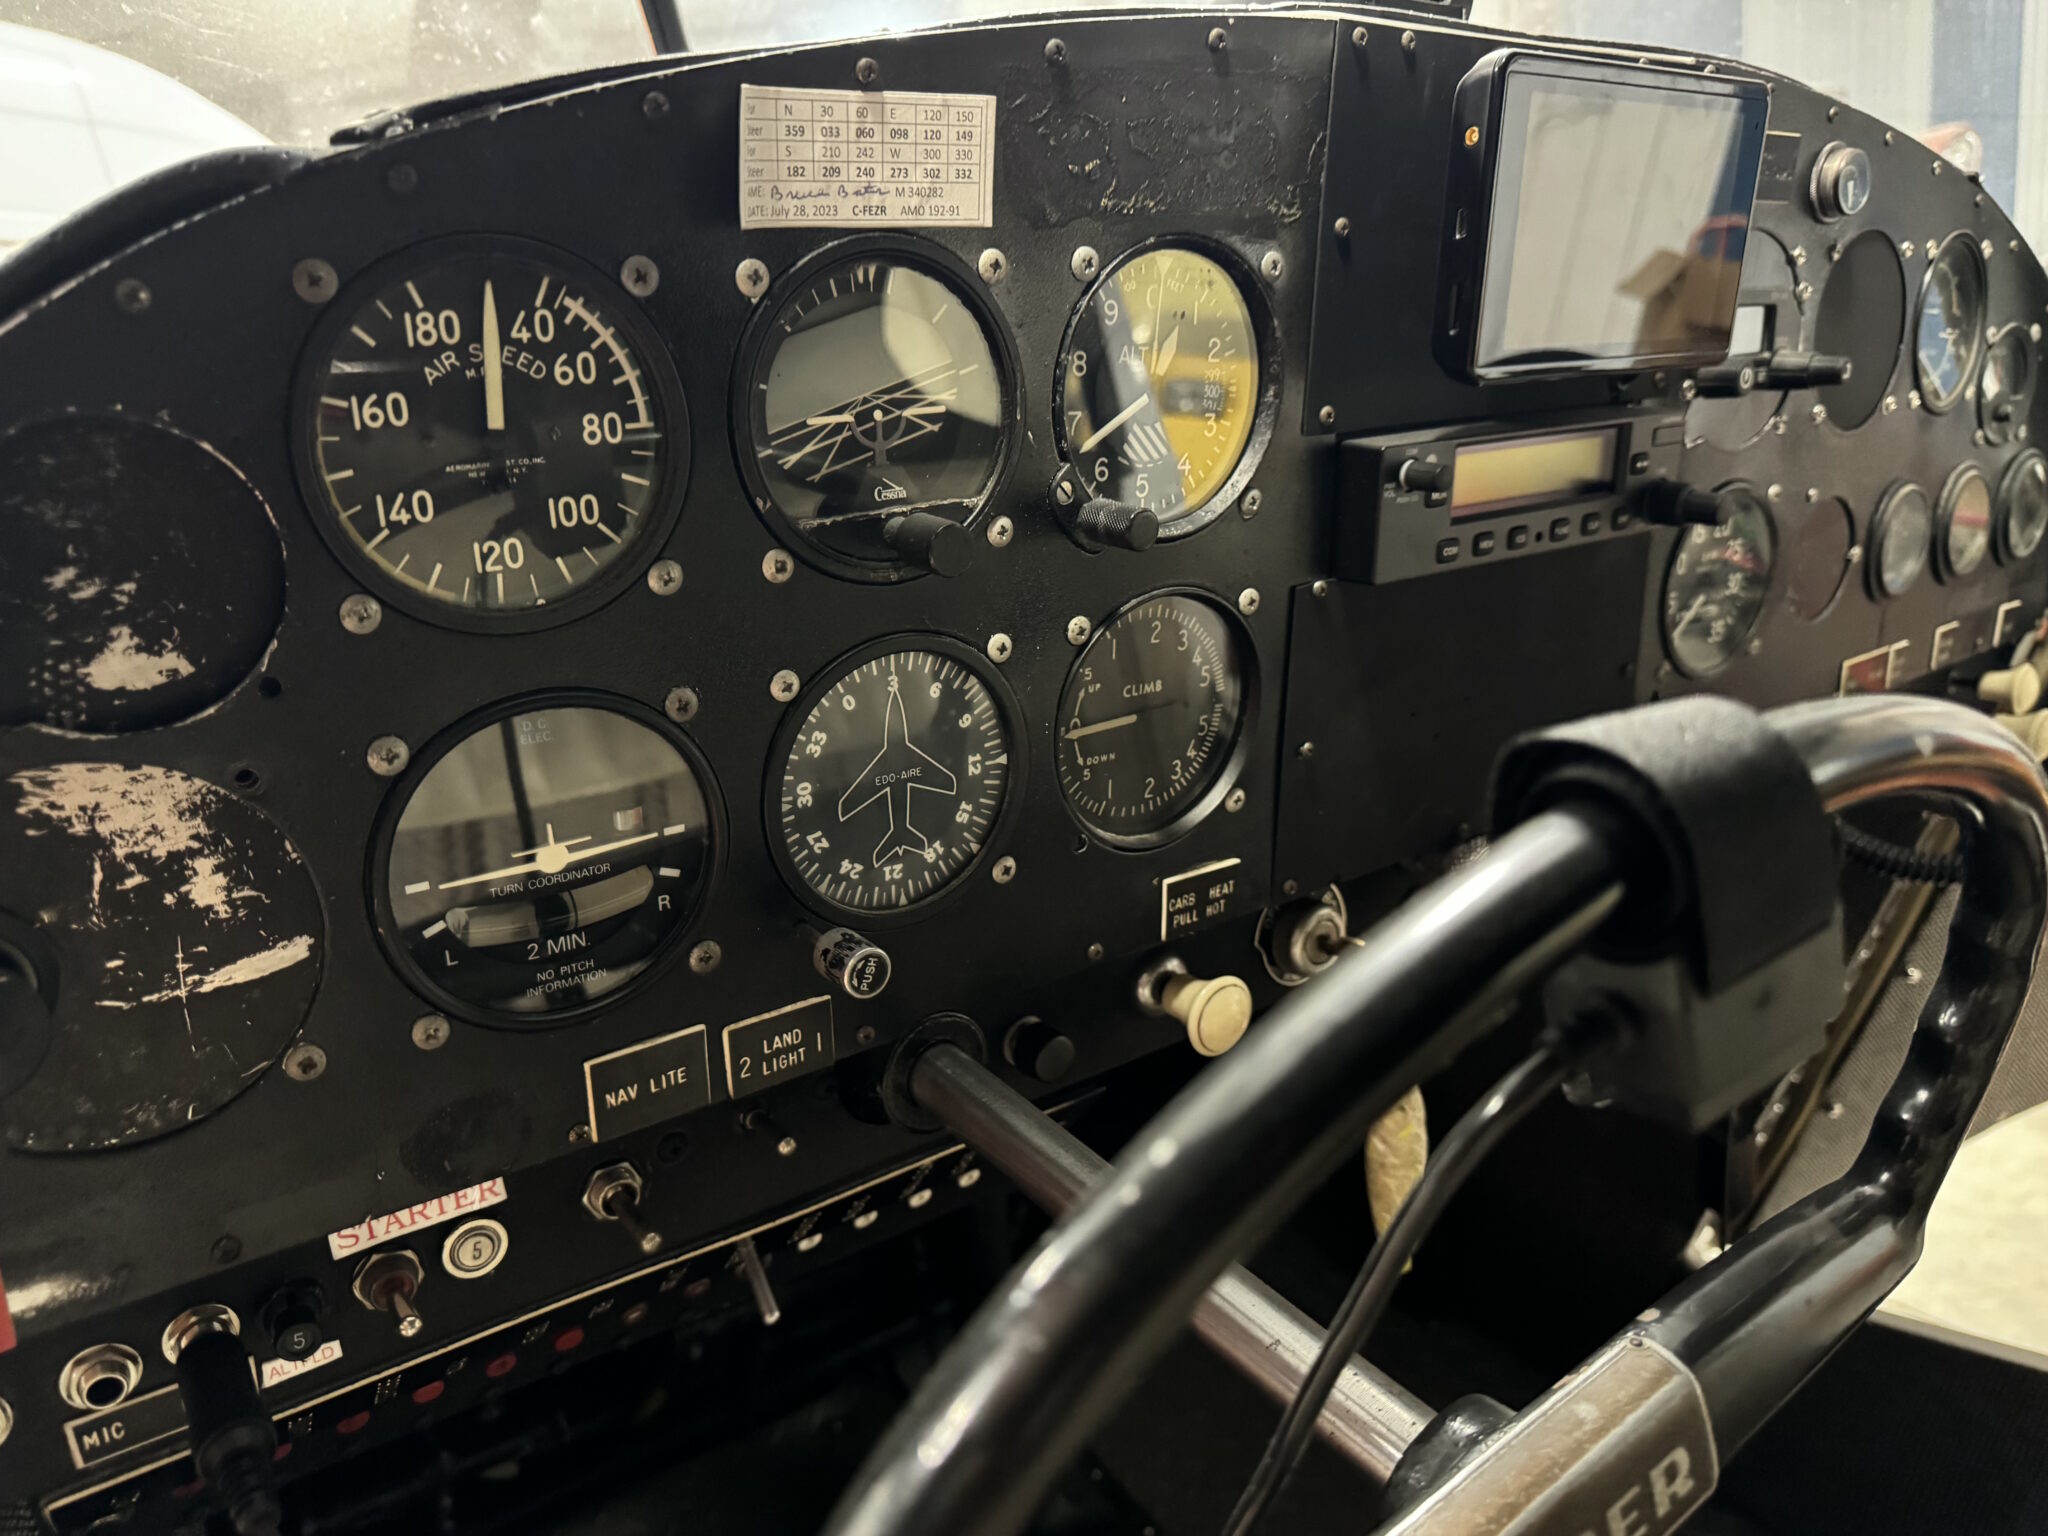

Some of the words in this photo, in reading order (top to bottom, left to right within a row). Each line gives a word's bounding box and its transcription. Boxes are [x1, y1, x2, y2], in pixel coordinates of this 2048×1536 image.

[784, 104, 793, 116] N
[820, 105, 834, 118] 30
[856, 106, 869, 119] 60
[890, 108, 897, 120] E
[923, 109, 942, 121] 120
[956, 111, 974, 123] 150
[785, 125, 805, 137] 359
[820, 126, 840, 138] 033
[856, 127, 875, 139] 060
[890, 128, 909, 140] 098
[923, 129, 941, 141] 120
[956, 130, 973, 142] 149
[785, 145, 792, 157] S
[821, 146, 841, 158] 210
[856, 147, 875, 159] 242
[890, 148, 901, 159] W
[923, 149, 941, 161] 300
[955, 150, 973, 161] 330
[786, 166, 806, 177] 182
[822, 166, 841, 178] 209
[856, 167, 875, 178] 240
[890, 168, 909, 179] 273
[923, 168, 941, 179] 302
[954, 169, 972, 180] 332
[895, 187, 905, 198] M
[908, 187, 944, 199] 340282
[770, 206, 790, 219] July
[793, 205, 809, 218] 28,
[812, 206, 839, 217] 2023
[852, 205, 887, 217] C-FEZR
[900, 206, 925, 217] AMO
[928, 206, 961, 217] 192-91
[1103, 299, 1119, 326] 9
[404, 309, 461, 347] 180
[510, 308, 555, 344] 40
[1118, 344, 1150, 365] ALT
[1207, 338, 1221, 363] 2
[423, 350, 460, 386] AIR
[468, 343, 547, 379] SEED
[553, 350, 597, 386] 60
[1072, 350, 1088, 377] 8
[1203, 384, 1221, 398] 300
[350, 391, 409, 431] 160
[582, 412, 623, 446] 80
[1067, 411, 1083, 436] 7
[1203, 412, 1217, 437] 3
[1094, 457, 1109, 482] 6
[1177, 452, 1192, 476] 4
[874, 485, 907, 501] Cessna
[1135, 473, 1150, 498] 5
[375, 489, 434, 528] 140
[548, 493, 599, 530] 100
[473, 537, 525, 574] 120
[1150, 620, 1162, 644] 2
[1177, 629, 1189, 652] 3
[1191, 645, 1203, 666] 4
[887, 675, 899, 692] 3
[1087, 682, 1102, 694] UP
[1122, 679, 1163, 698] CLIMB
[1198, 665, 1211, 688] 5
[929, 681, 943, 699] 6
[841, 694, 856, 711] 0
[958, 713, 972, 729] 9
[1197, 714, 1209, 737] 5
[805, 730, 828, 758] 33
[1186, 738, 1198, 760] 4
[967, 753, 983, 776] 12
[1086, 752, 1116, 766] DOWN
[1170, 759, 1182, 781] 3
[874, 767, 923, 787] EDO-AIRE
[1143, 777, 1156, 799] 2
[796, 781, 813, 809] 30
[955, 800, 973, 824] 15
[805, 830, 830, 855] 27
[923, 838, 946, 864] 18
[489, 881, 524, 899] TURN
[527, 862, 611, 890] COORDINATOR
[839, 857, 865, 880] 24
[883, 862, 904, 882] 21
[657, 894, 672, 912] R
[1168, 892, 1197, 912] CARB
[1209, 880, 1235, 899] HEAT
[1173, 909, 1199, 928] PULL
[1206, 899, 1226, 917] HOT
[445, 949, 459, 967] L
[527, 942, 541, 961] 2
[547, 931, 592, 957] MIN.
[536, 968, 556, 983] NO
[560, 958, 595, 977] PITCH
[860, 957, 879, 991] PUSH
[526, 967, 608, 999] INFORMATION
[739, 1056, 752, 1079] 2
[763, 1028, 802, 1055] LAND
[762, 1047, 807, 1077] LIGHT
[605, 1083, 639, 1110] NAV
[650, 1066, 688, 1094] LITE
[336, 1179, 503, 1251] STARTER
[471, 1241, 483, 1260] 5
[293, 1332, 306, 1350] 5
[81, 1421, 126, 1450] MIC
[1577, 1446, 1695, 1536] ER
